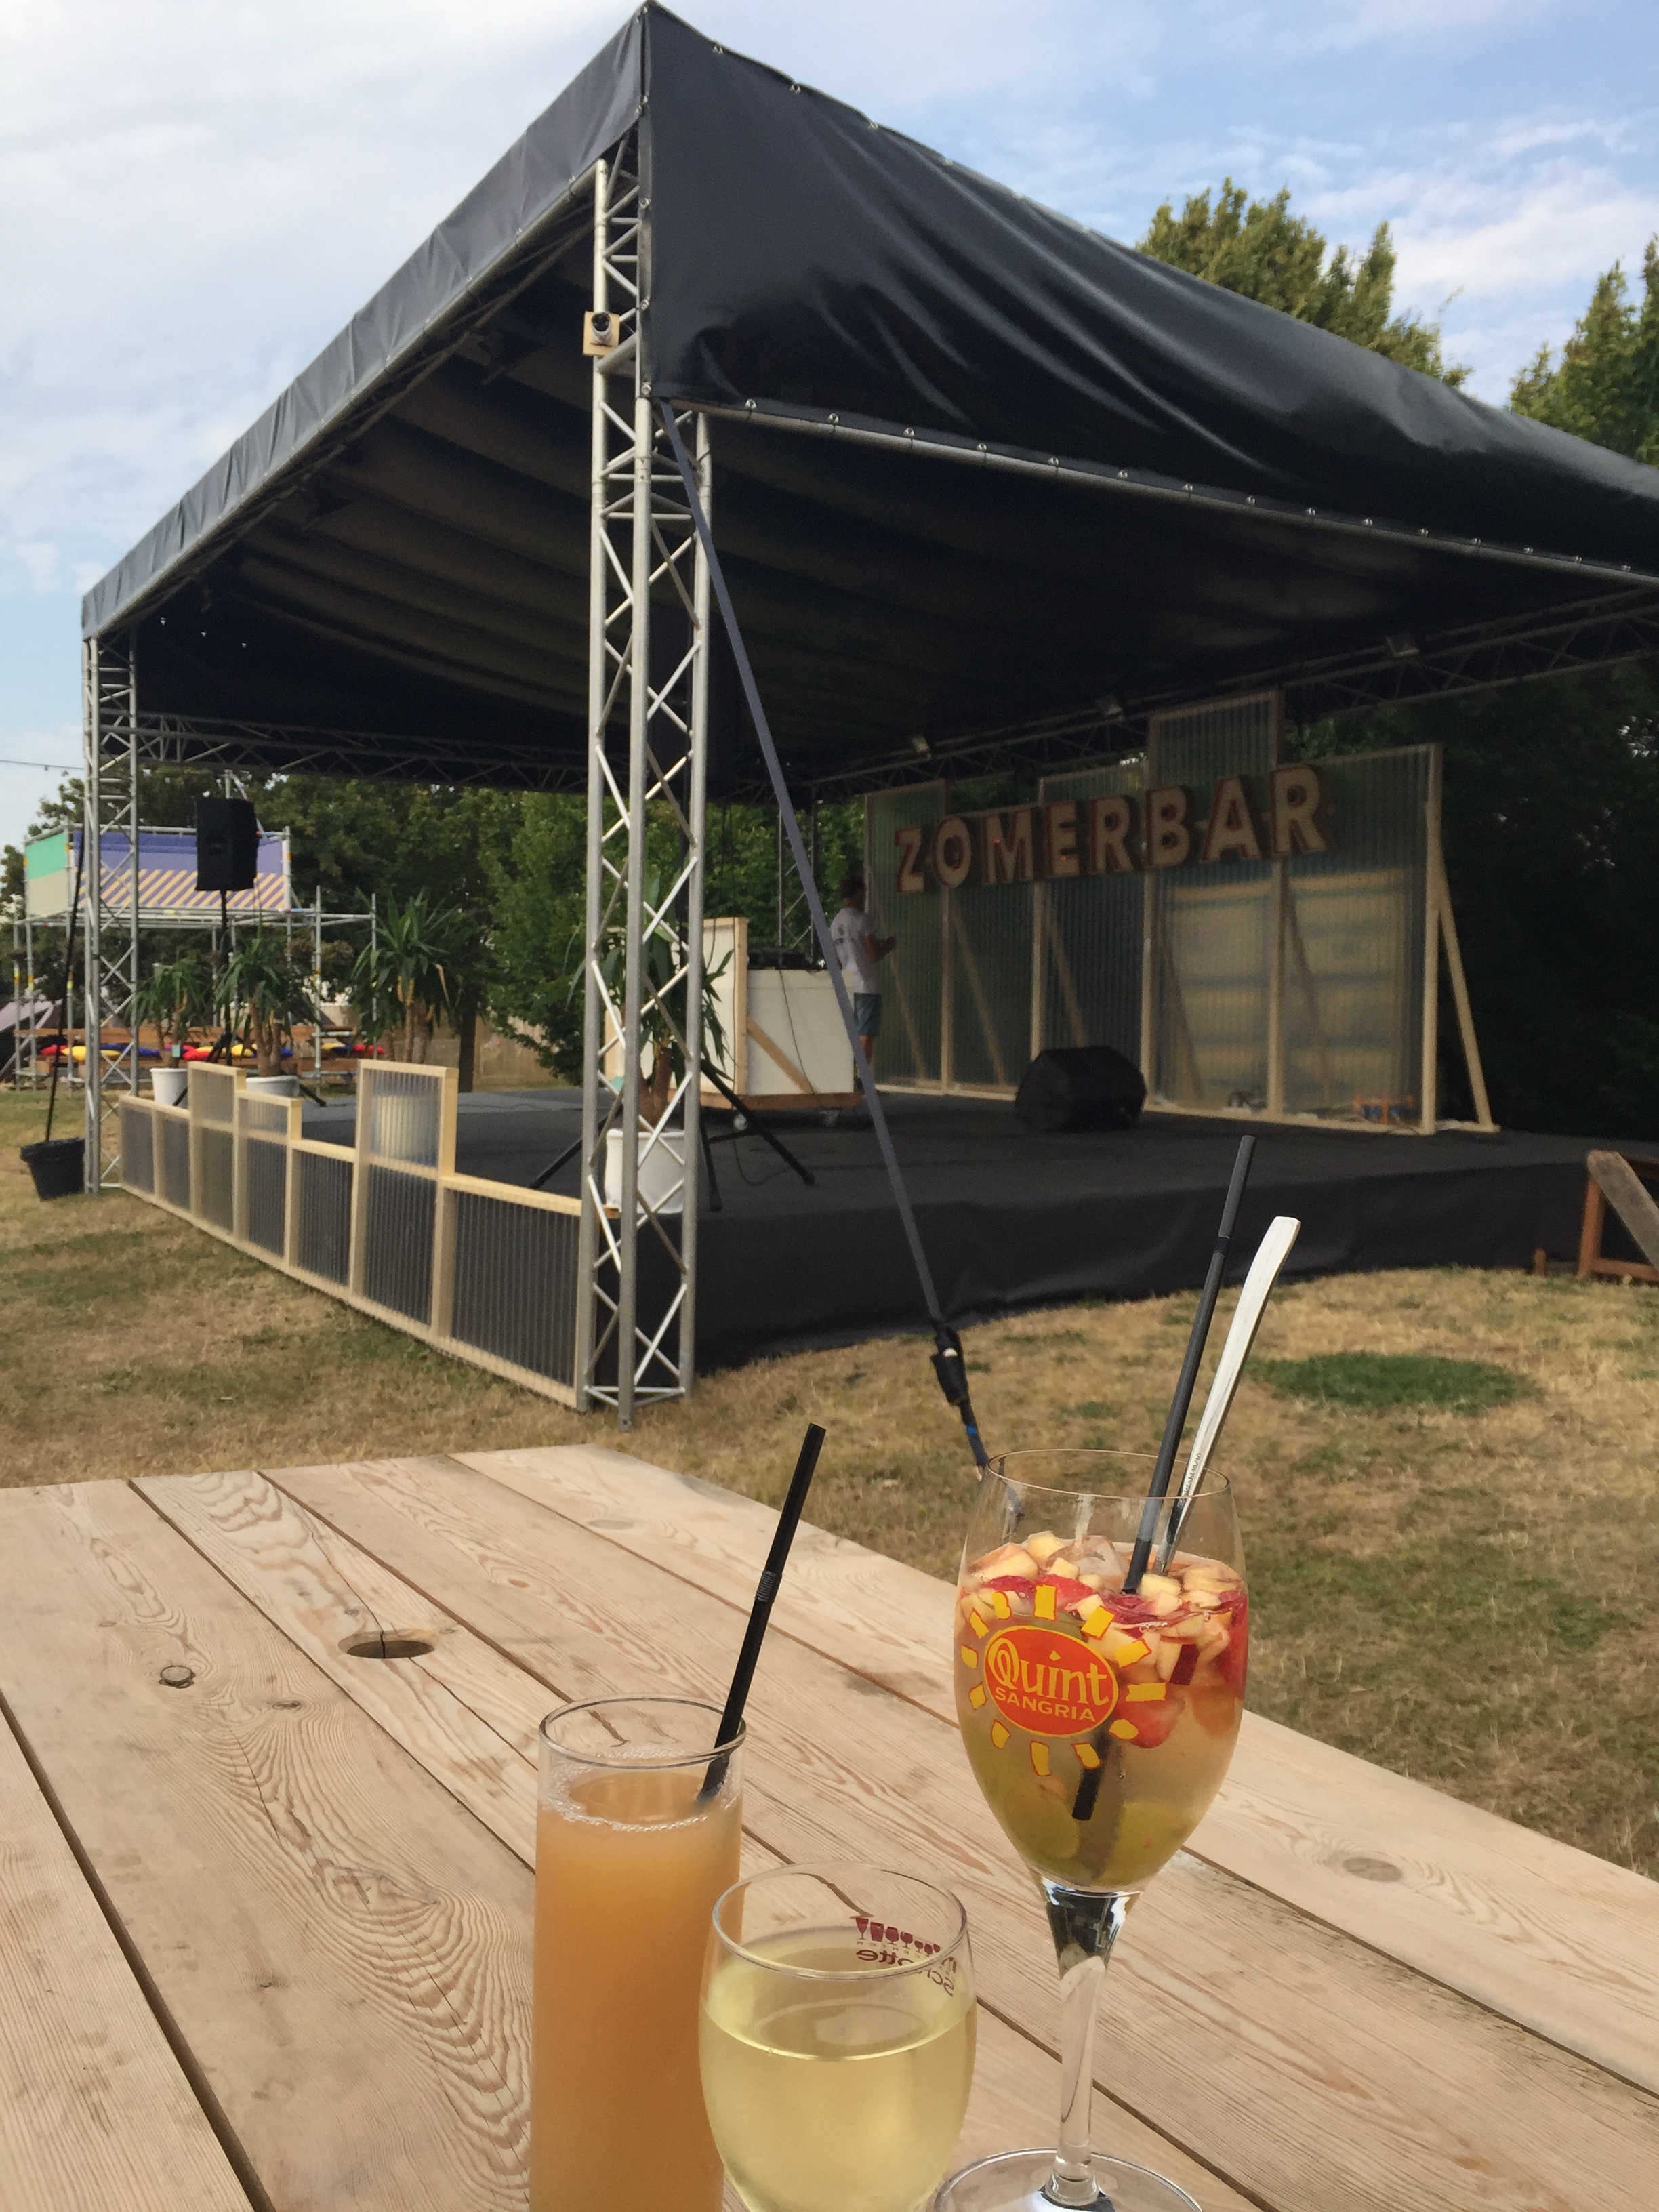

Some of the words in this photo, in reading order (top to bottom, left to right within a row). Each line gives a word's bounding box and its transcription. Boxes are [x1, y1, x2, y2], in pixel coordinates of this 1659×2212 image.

[894, 764, 1330, 894] ZOMERBAR
[987, 1637, 1109, 1706] Quint
[994, 1687, 1096, 1723] SANGRIA
